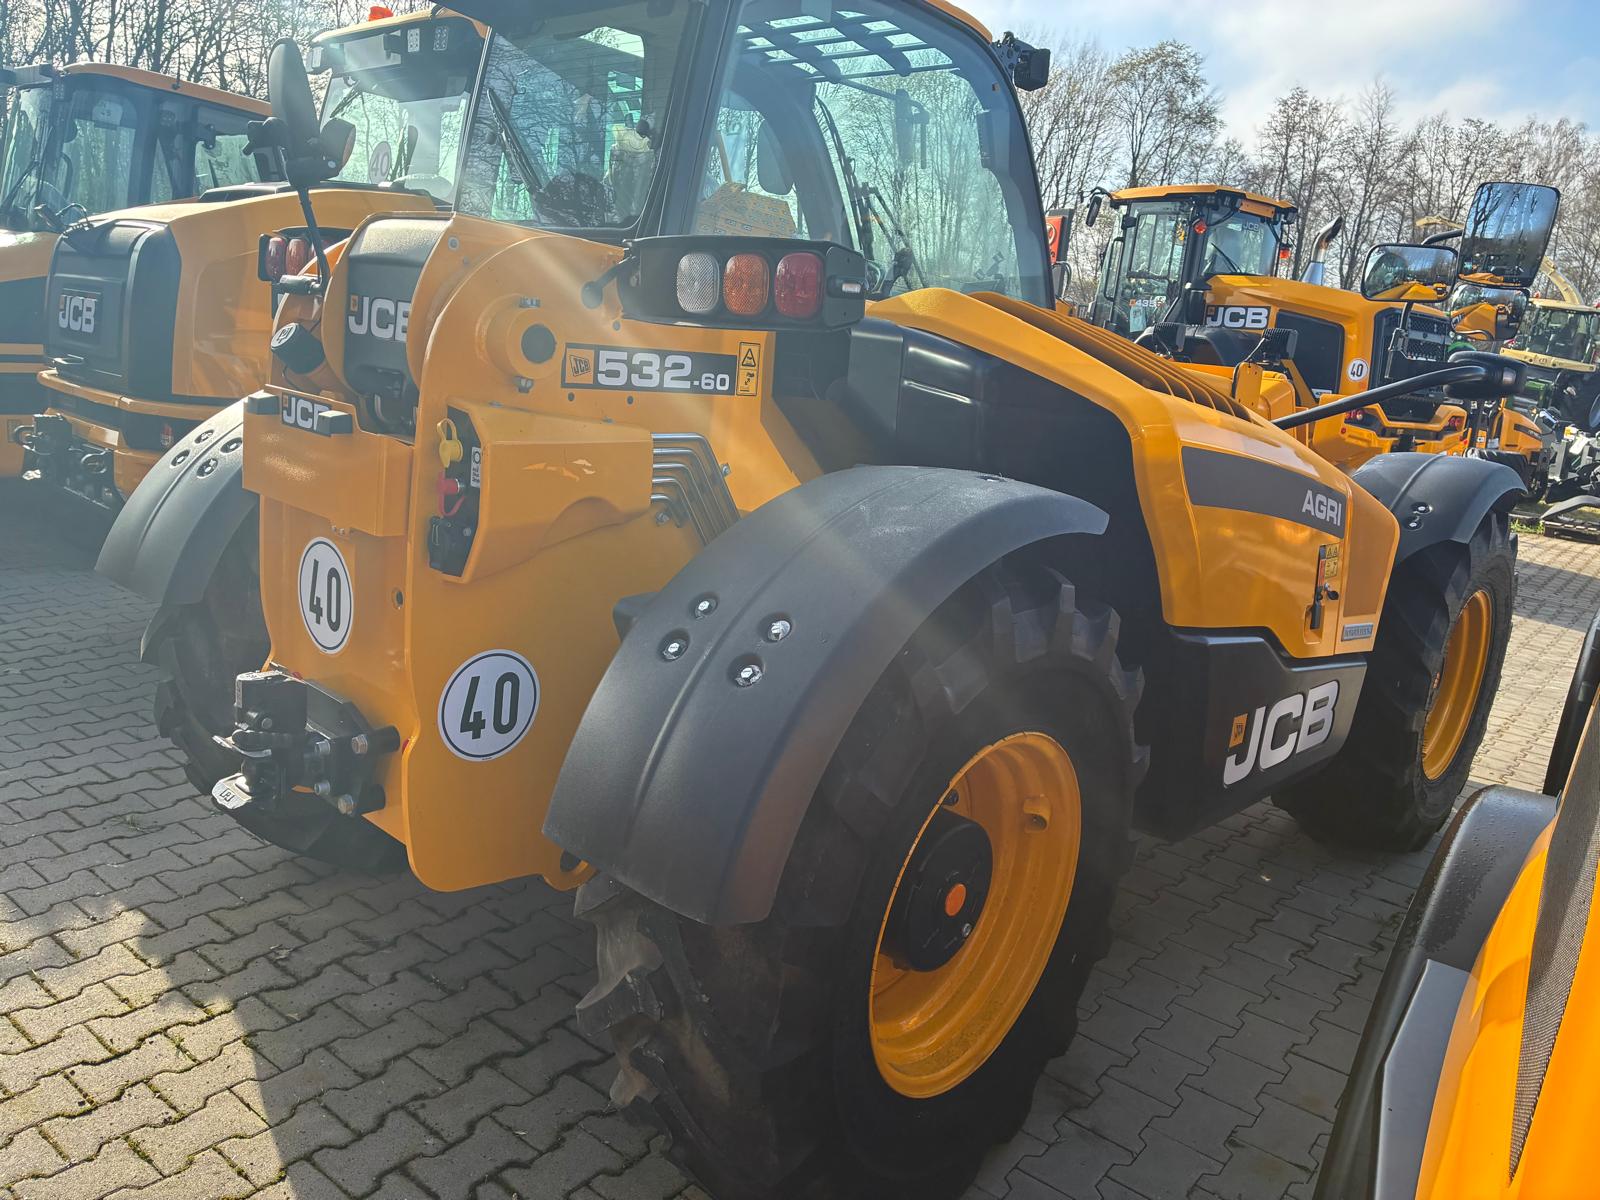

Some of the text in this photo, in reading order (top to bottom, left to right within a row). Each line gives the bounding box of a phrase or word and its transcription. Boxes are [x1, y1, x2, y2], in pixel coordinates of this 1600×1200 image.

[371, 152, 390, 177] 40
[1243, 221, 1260, 232] JCB
[59, 295, 96, 333] JCB
[1206, 306, 1269, 329] JCB
[571, 355, 591, 376] JCB
[1350, 362, 1364, 378] 40
[1301, 489, 1342, 527] AGRI
[309, 558, 341, 632] 40
[460, 671, 520, 740] 40
[1223, 680, 1339, 785] JCB
